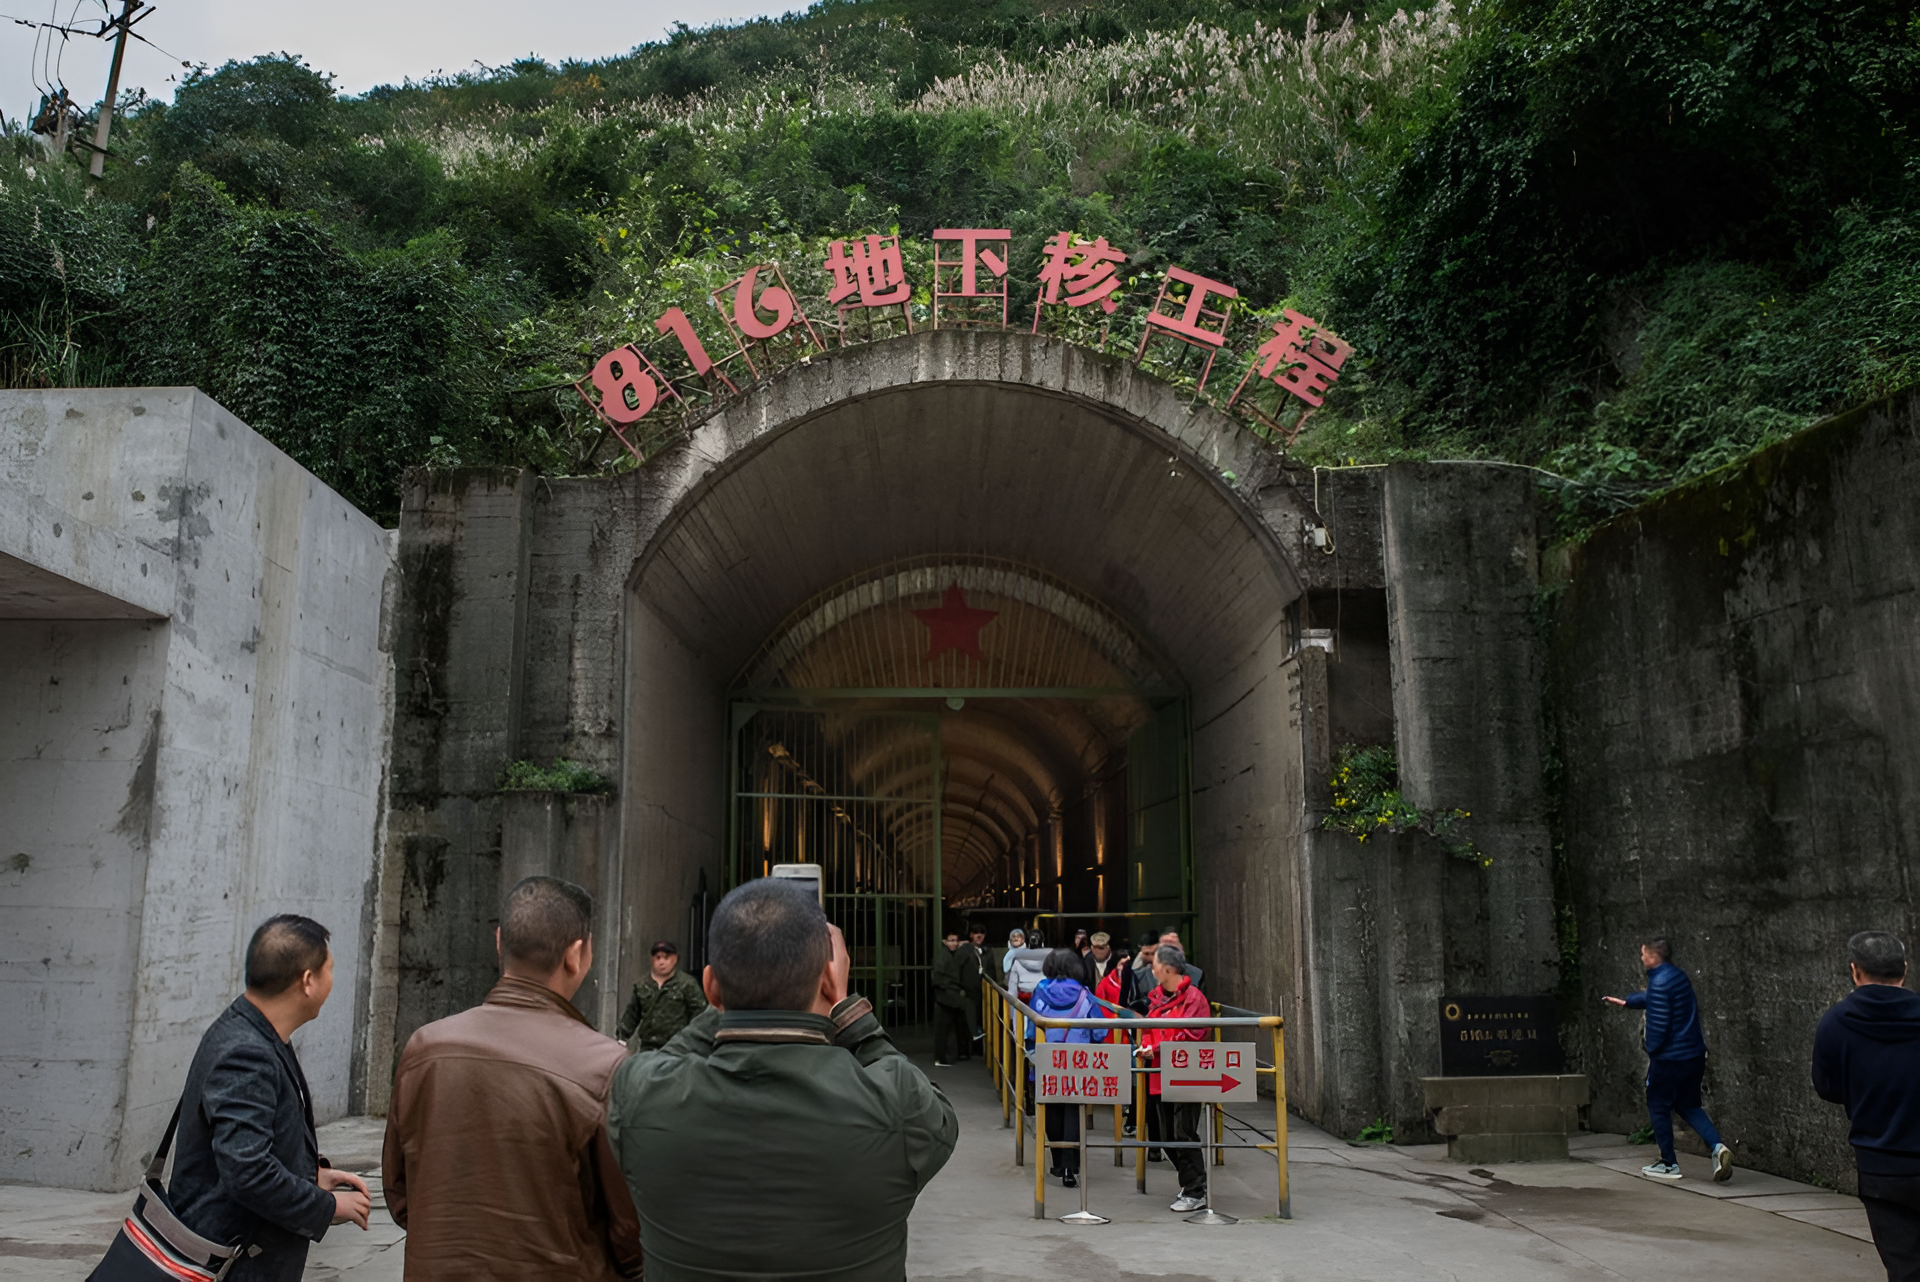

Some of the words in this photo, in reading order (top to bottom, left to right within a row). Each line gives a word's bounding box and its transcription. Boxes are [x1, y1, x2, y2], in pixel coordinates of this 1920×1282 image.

[591, 228, 1356, 424] 816地下核工程
